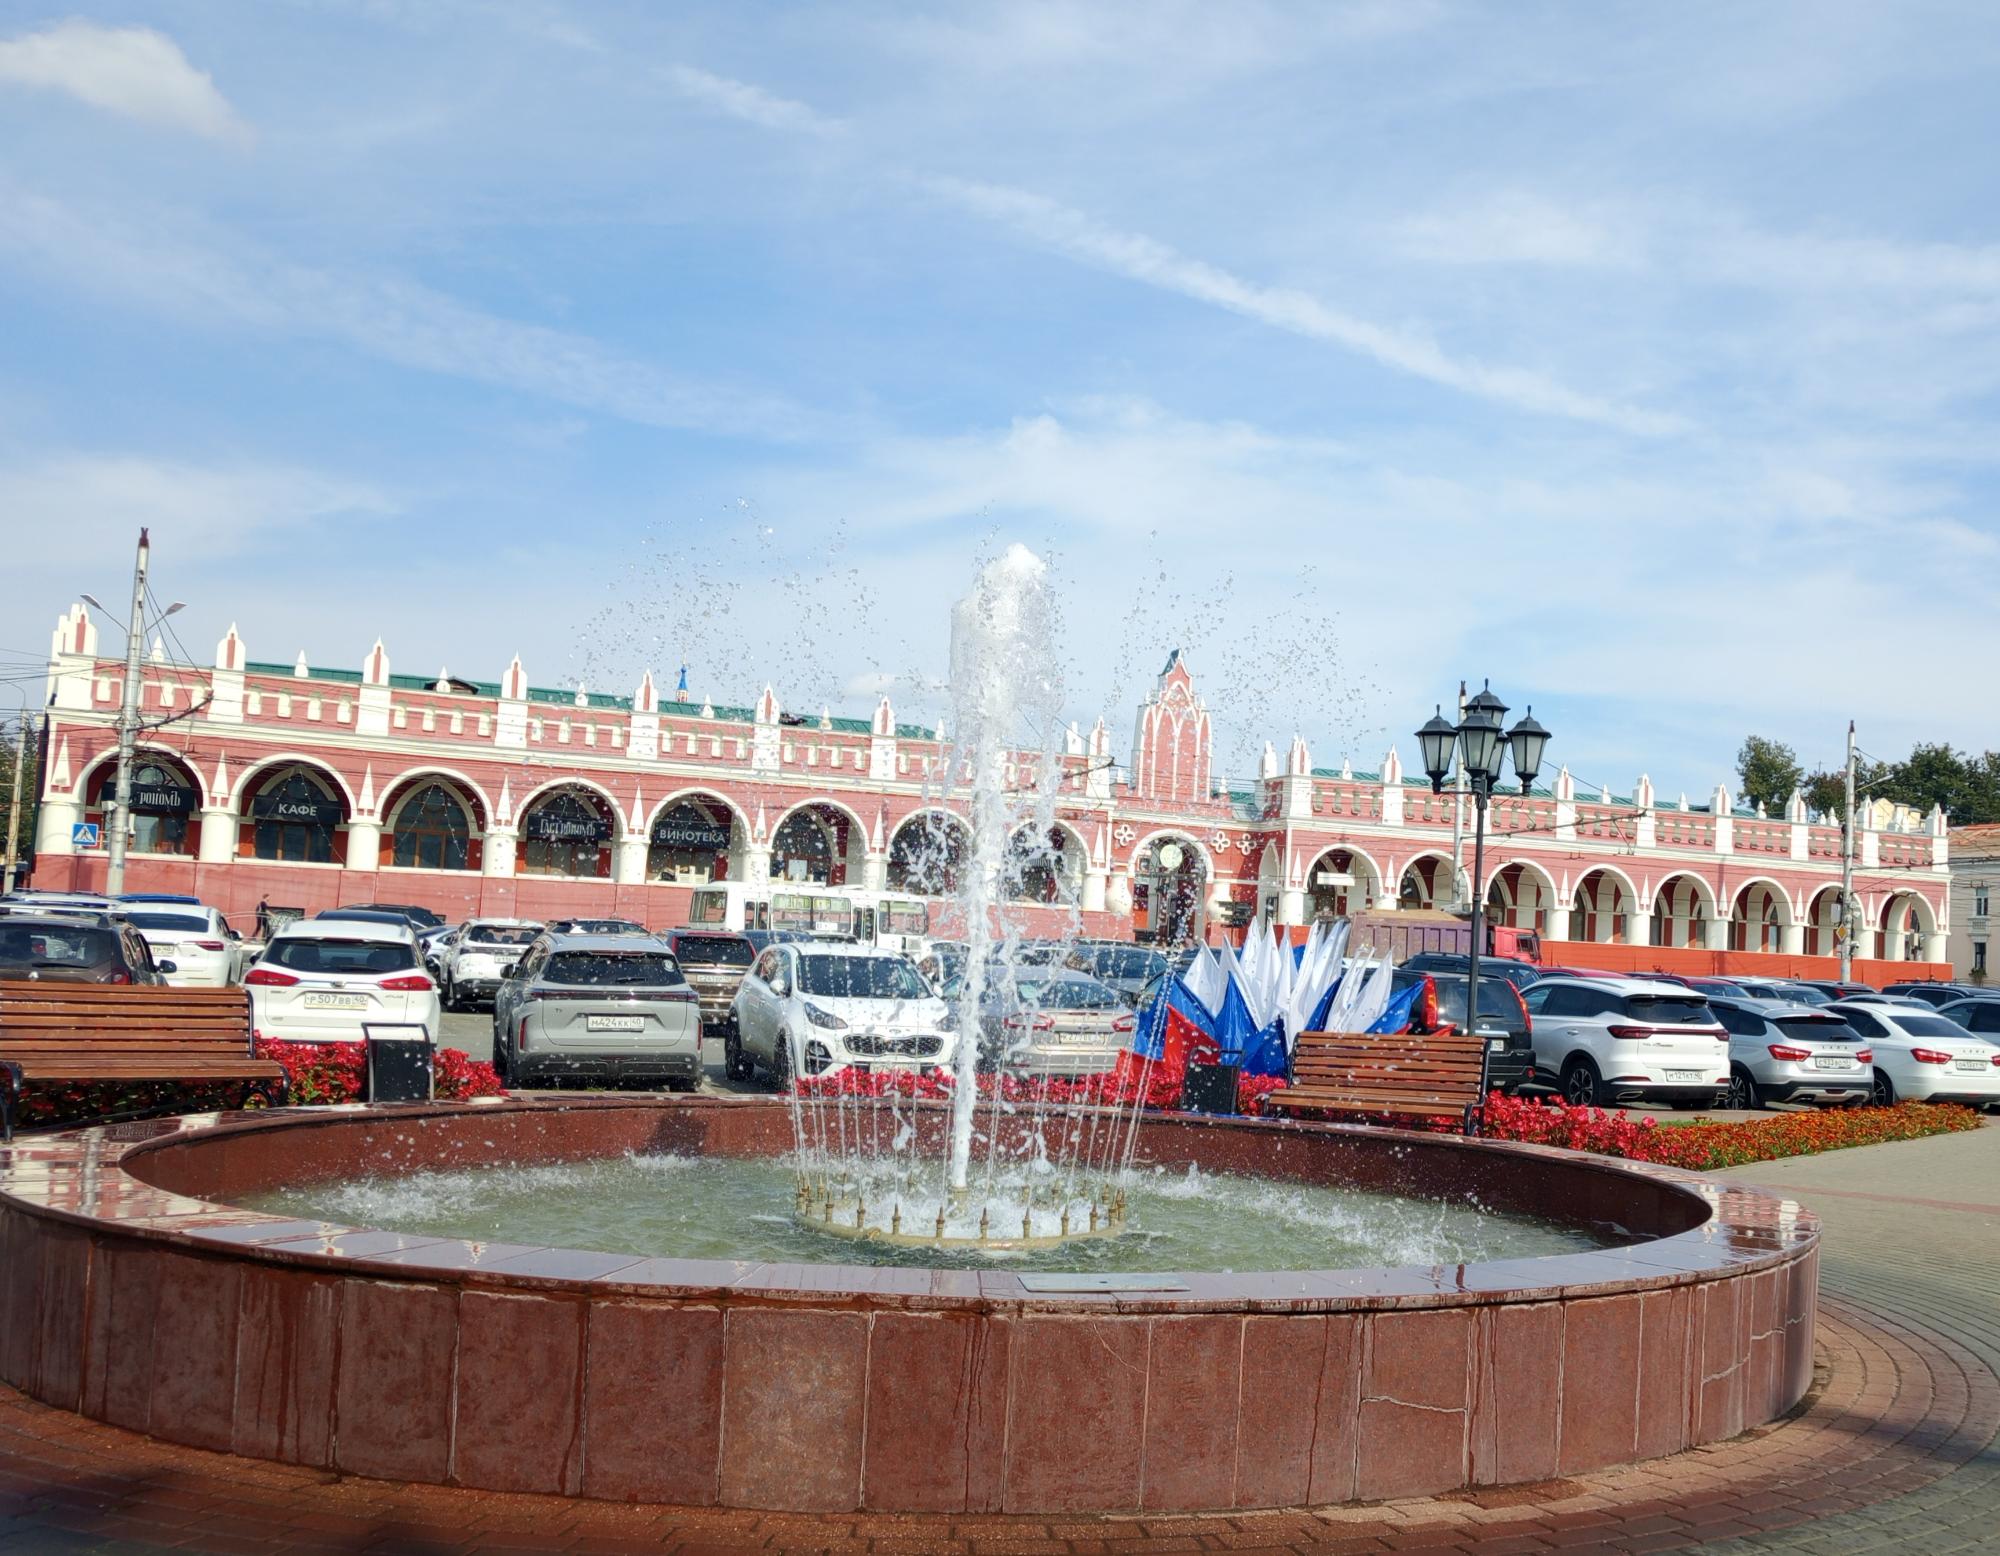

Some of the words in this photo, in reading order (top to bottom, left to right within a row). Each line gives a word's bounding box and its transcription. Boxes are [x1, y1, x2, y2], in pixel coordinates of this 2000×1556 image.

[129, 791, 181, 806] РОНОМЪ
[278, 803, 318, 817] КАФЕ
[659, 829, 726, 843] ВИНОТЕКА
